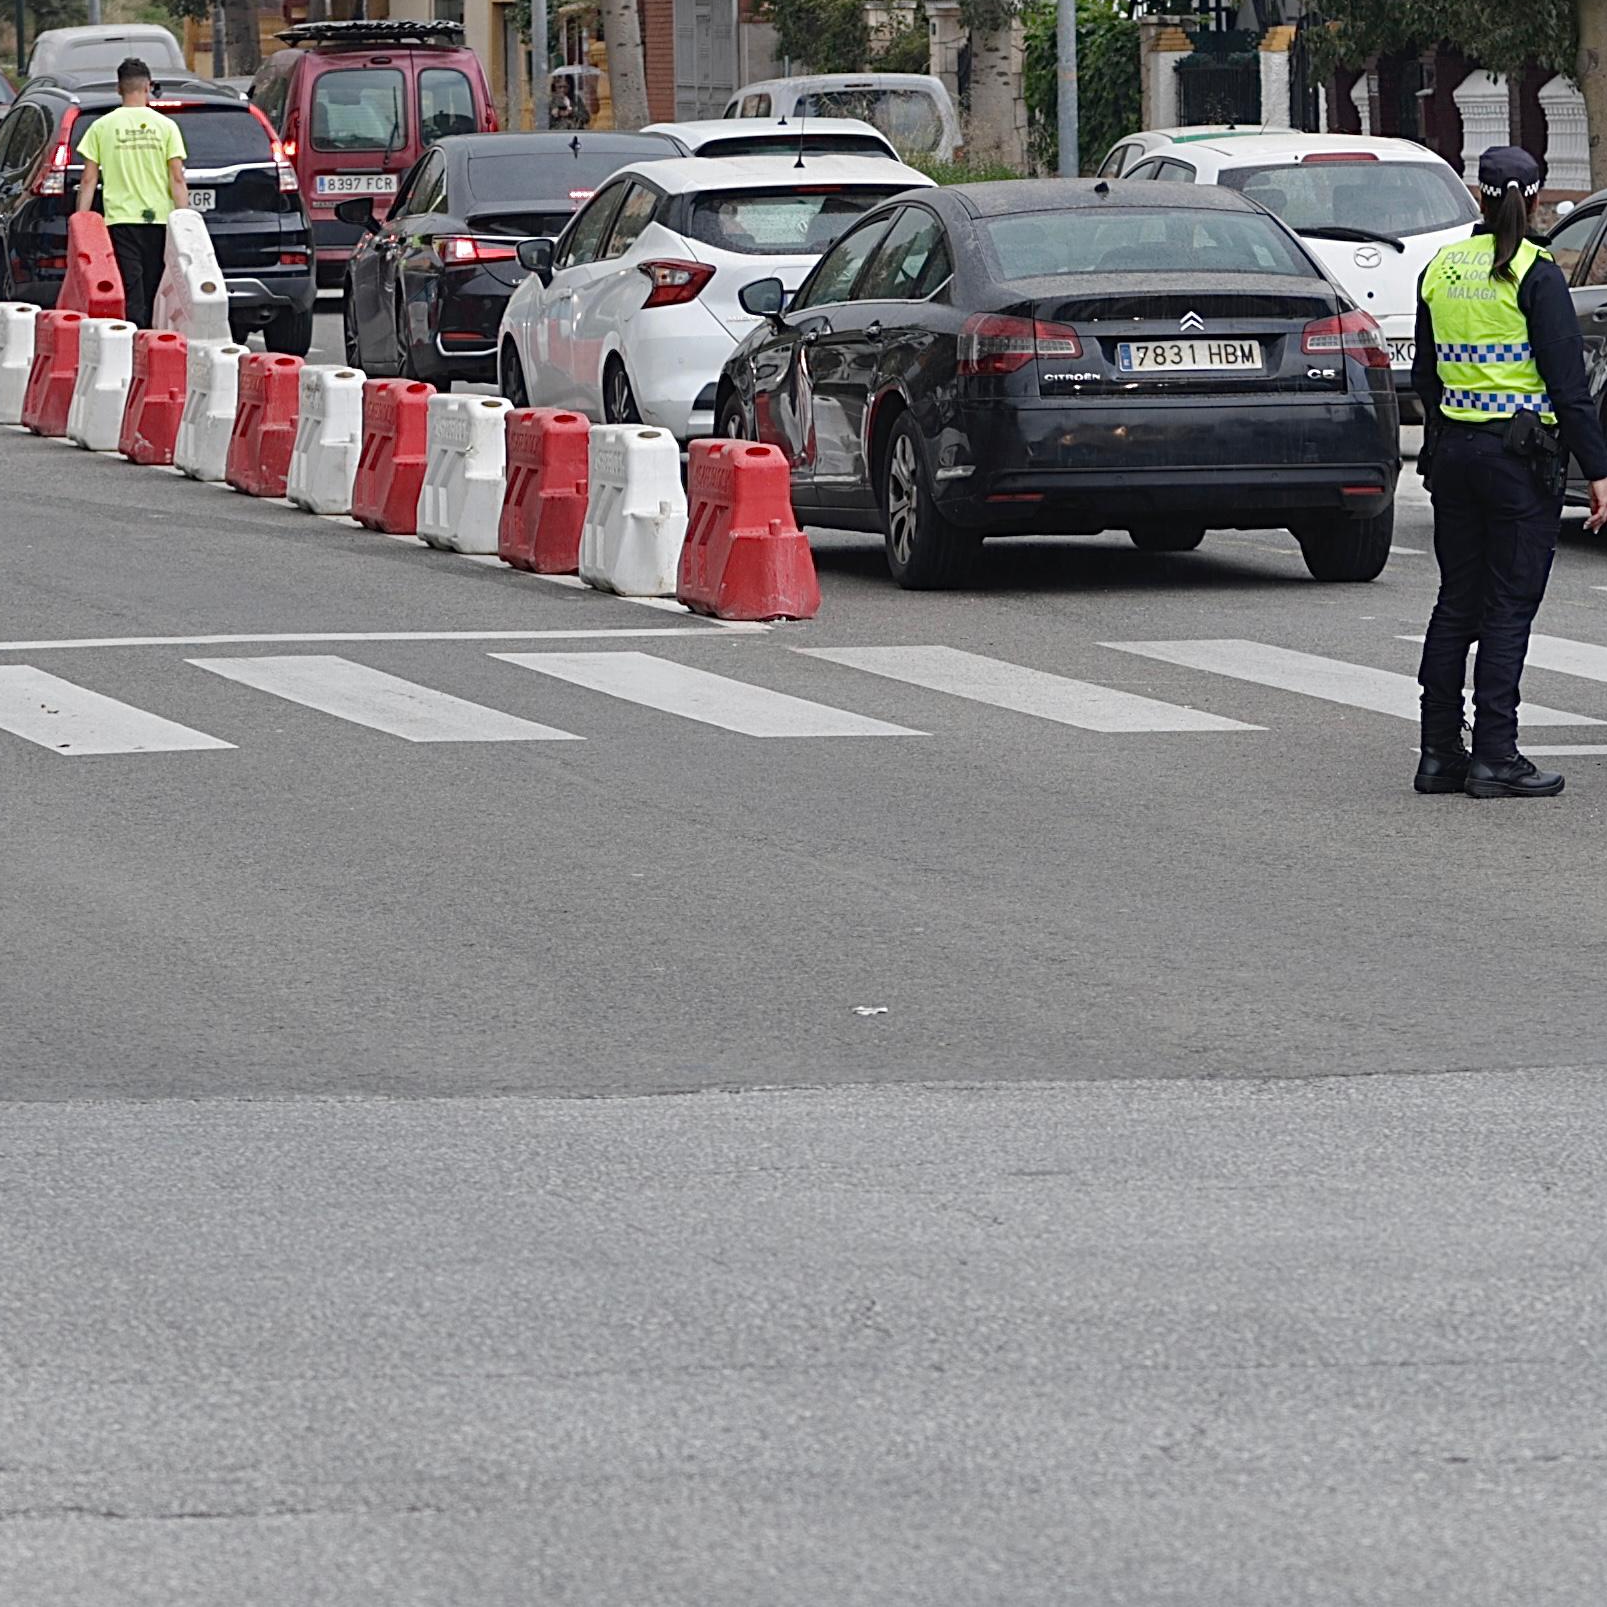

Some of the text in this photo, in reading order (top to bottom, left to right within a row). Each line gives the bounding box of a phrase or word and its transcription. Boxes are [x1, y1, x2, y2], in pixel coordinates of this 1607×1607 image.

[327, 177, 393, 191] 8397 FCR
[1136, 344, 1197, 367] 7831
[1208, 343, 1255, 365] HBM
[1044, 372, 1101, 382] CITROËN
[1307, 368, 1336, 380] C5
